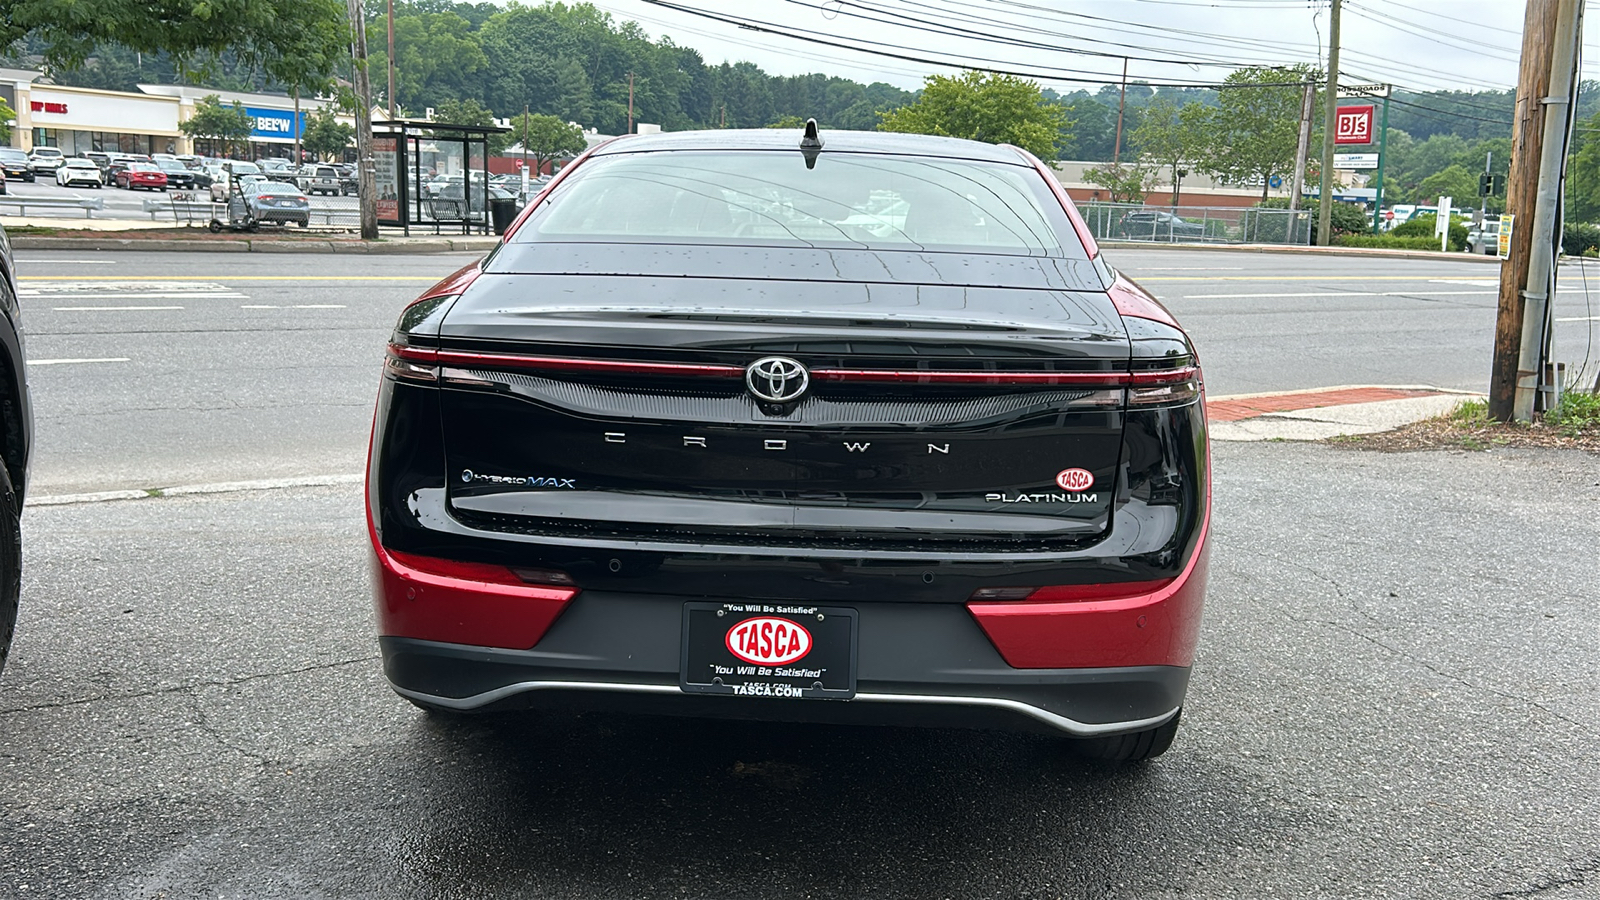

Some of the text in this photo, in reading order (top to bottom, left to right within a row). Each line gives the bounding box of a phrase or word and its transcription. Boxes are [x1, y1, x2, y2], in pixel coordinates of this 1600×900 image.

[604, 432, 950, 454] CROWN
[1060, 471, 1090, 489] TASCA
[985, 492, 1098, 504] PLATINUM
[736, 621, 801, 659] TASCA
[736, 666, 756, 675] Will
[757, 667, 772, 676] Be
[732, 686, 803, 697] TASCA.COM
